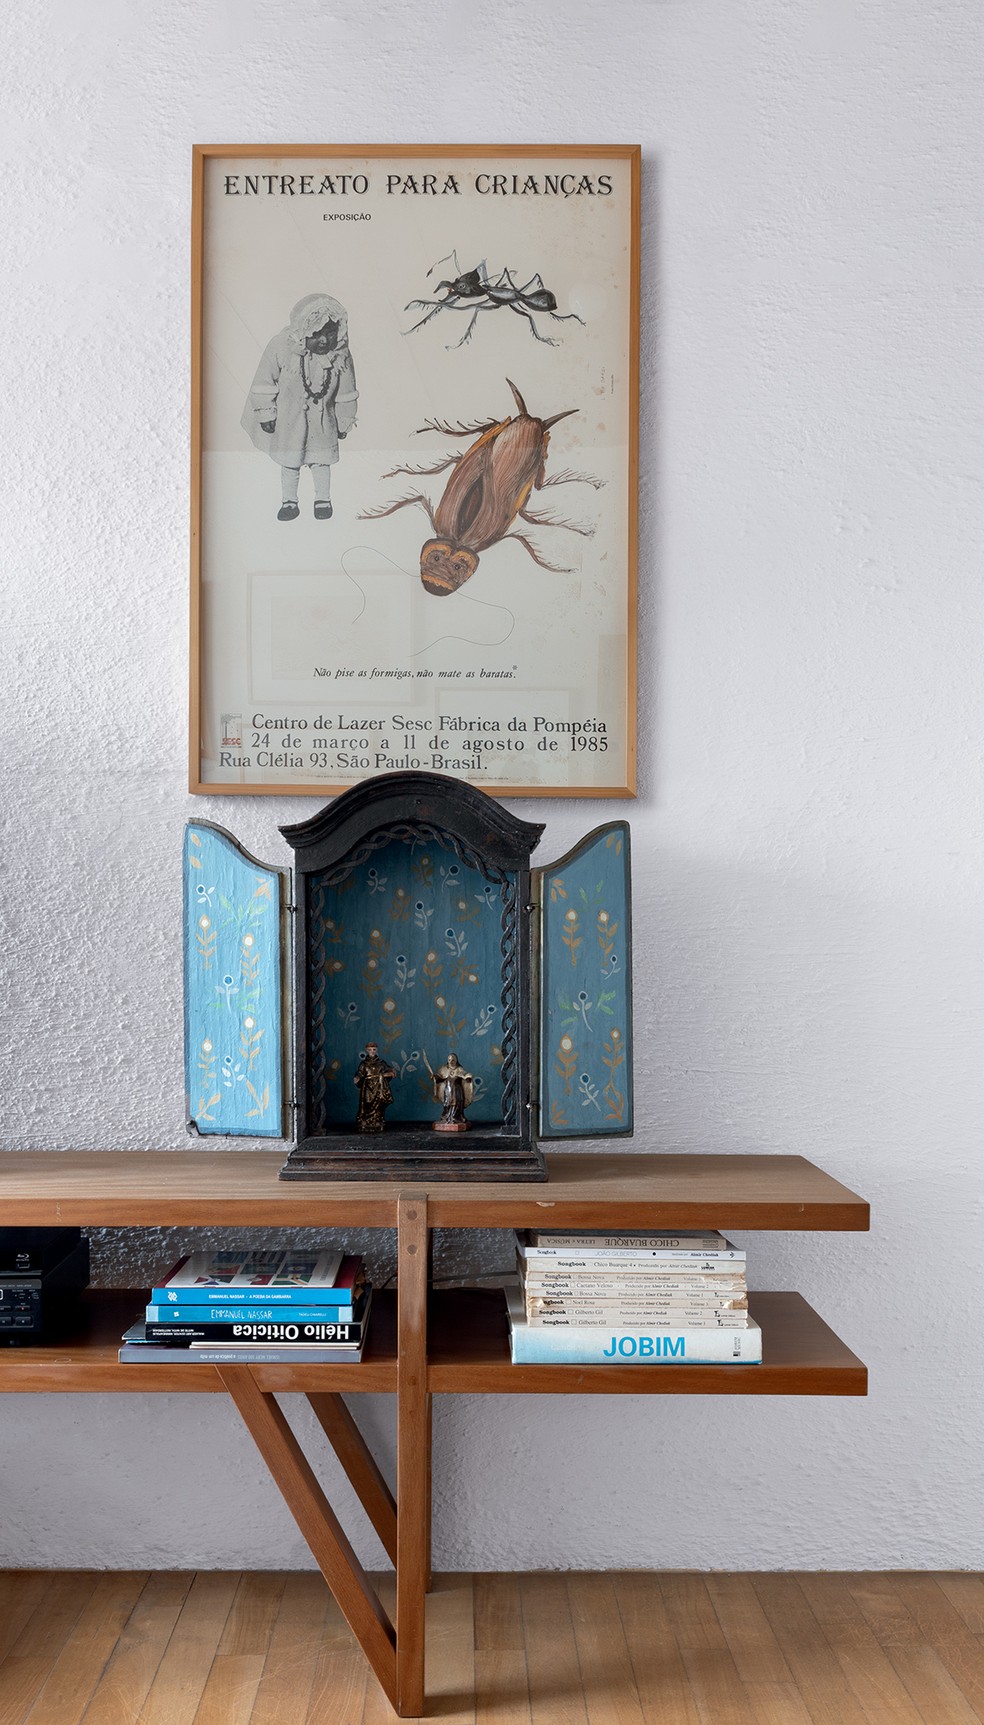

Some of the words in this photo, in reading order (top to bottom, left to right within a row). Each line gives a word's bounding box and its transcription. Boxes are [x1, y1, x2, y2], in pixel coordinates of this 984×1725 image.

[224, 175, 368, 196] ENTREATO
[386, 174, 460, 196] PARA
[475, 174, 613, 198] CRIANÇAS
[323, 213, 372, 221] EXPOSIÇÃO
[313, 668, 332, 677] Não
[335, 668, 355, 679] pise
[357, 669, 367, 677] as
[370, 668, 415, 680] formigas,
[416, 669, 434, 678] não
[438, 670, 461, 678] mate
[252, 714, 308, 730] Centro
[313, 715, 333, 730] de
[337, 715, 386, 730] Lazer
[392, 715, 432, 731] Sesc
[439, 716, 500, 731] Fábrica
[507, 717, 527, 732] da
[533, 717, 607, 736] Pompéia
[251, 733, 271, 748] 24
[281, 734, 302, 749] de
[312, 737, 369, 751] março
[380, 738, 390, 749] a
[429, 735, 449, 750] de
[462, 738, 525, 753] agosto
[537, 737, 558, 751] de
[570, 736, 608, 752] 1985
[219, 752, 251, 768] Rua
[256, 752, 304, 768] Clélia
[336, 753, 370, 769] São
[604, 1237, 647, 1247] BUARQUE
[649, 1239, 680, 1247] CHICO
[210, 1309, 245, 1319] EMMANUEL
[247, 1310, 273, 1320] NASSAR
[232, 1324, 299, 1340] Oiticica
[304, 1324, 349, 1340] Hélio
[603, 1336, 685, 1357] JOBIM
